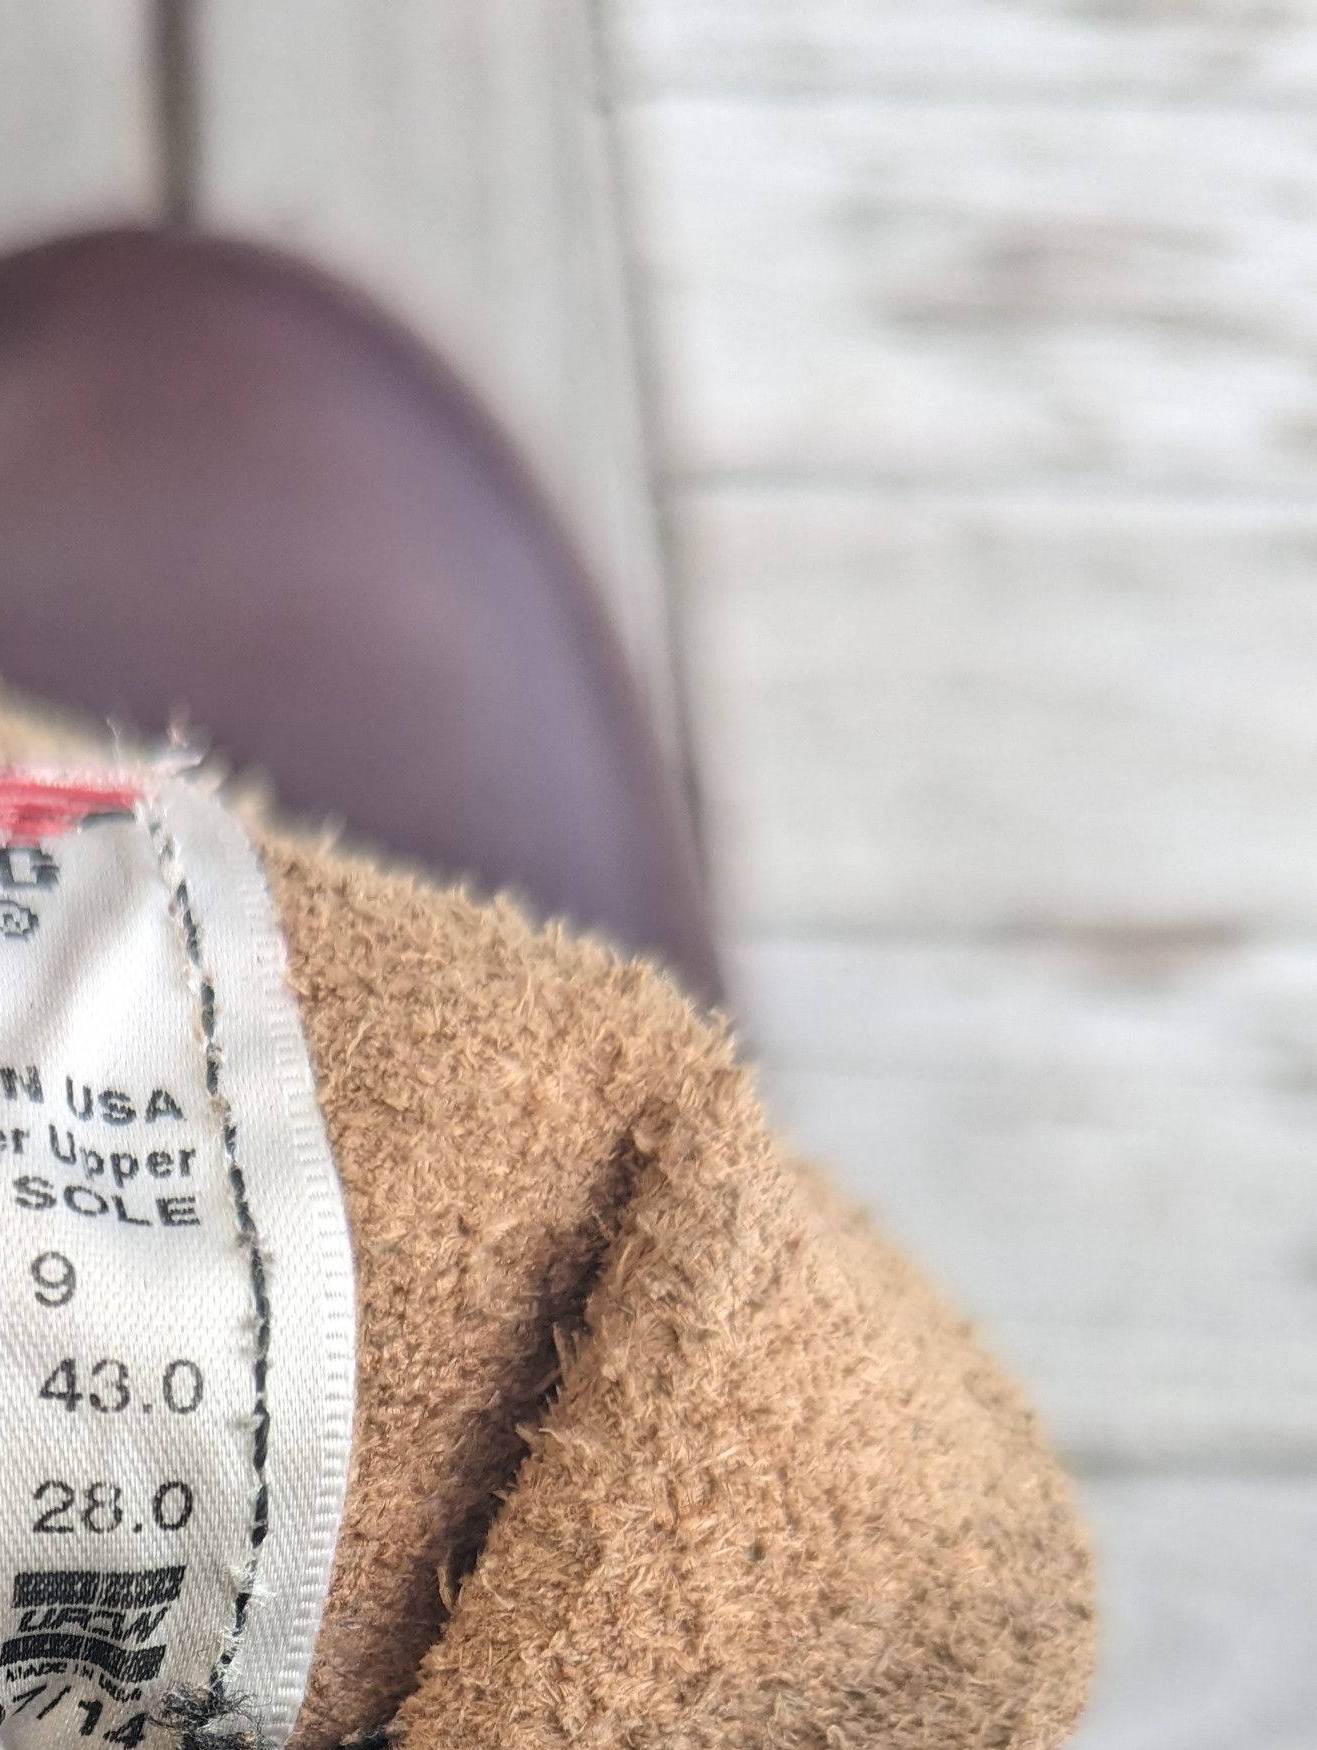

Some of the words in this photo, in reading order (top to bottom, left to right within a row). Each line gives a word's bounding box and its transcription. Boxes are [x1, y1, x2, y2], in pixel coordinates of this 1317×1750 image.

[64, 1074, 189, 1126] USA
[48, 1123, 197, 1188] Upper
[12, 1174, 202, 1228] SOLE
[30, 1250, 79, 1308] 9
[37, 1357, 205, 1416] 43.0
[32, 1480, 195, 1535] 28.0
